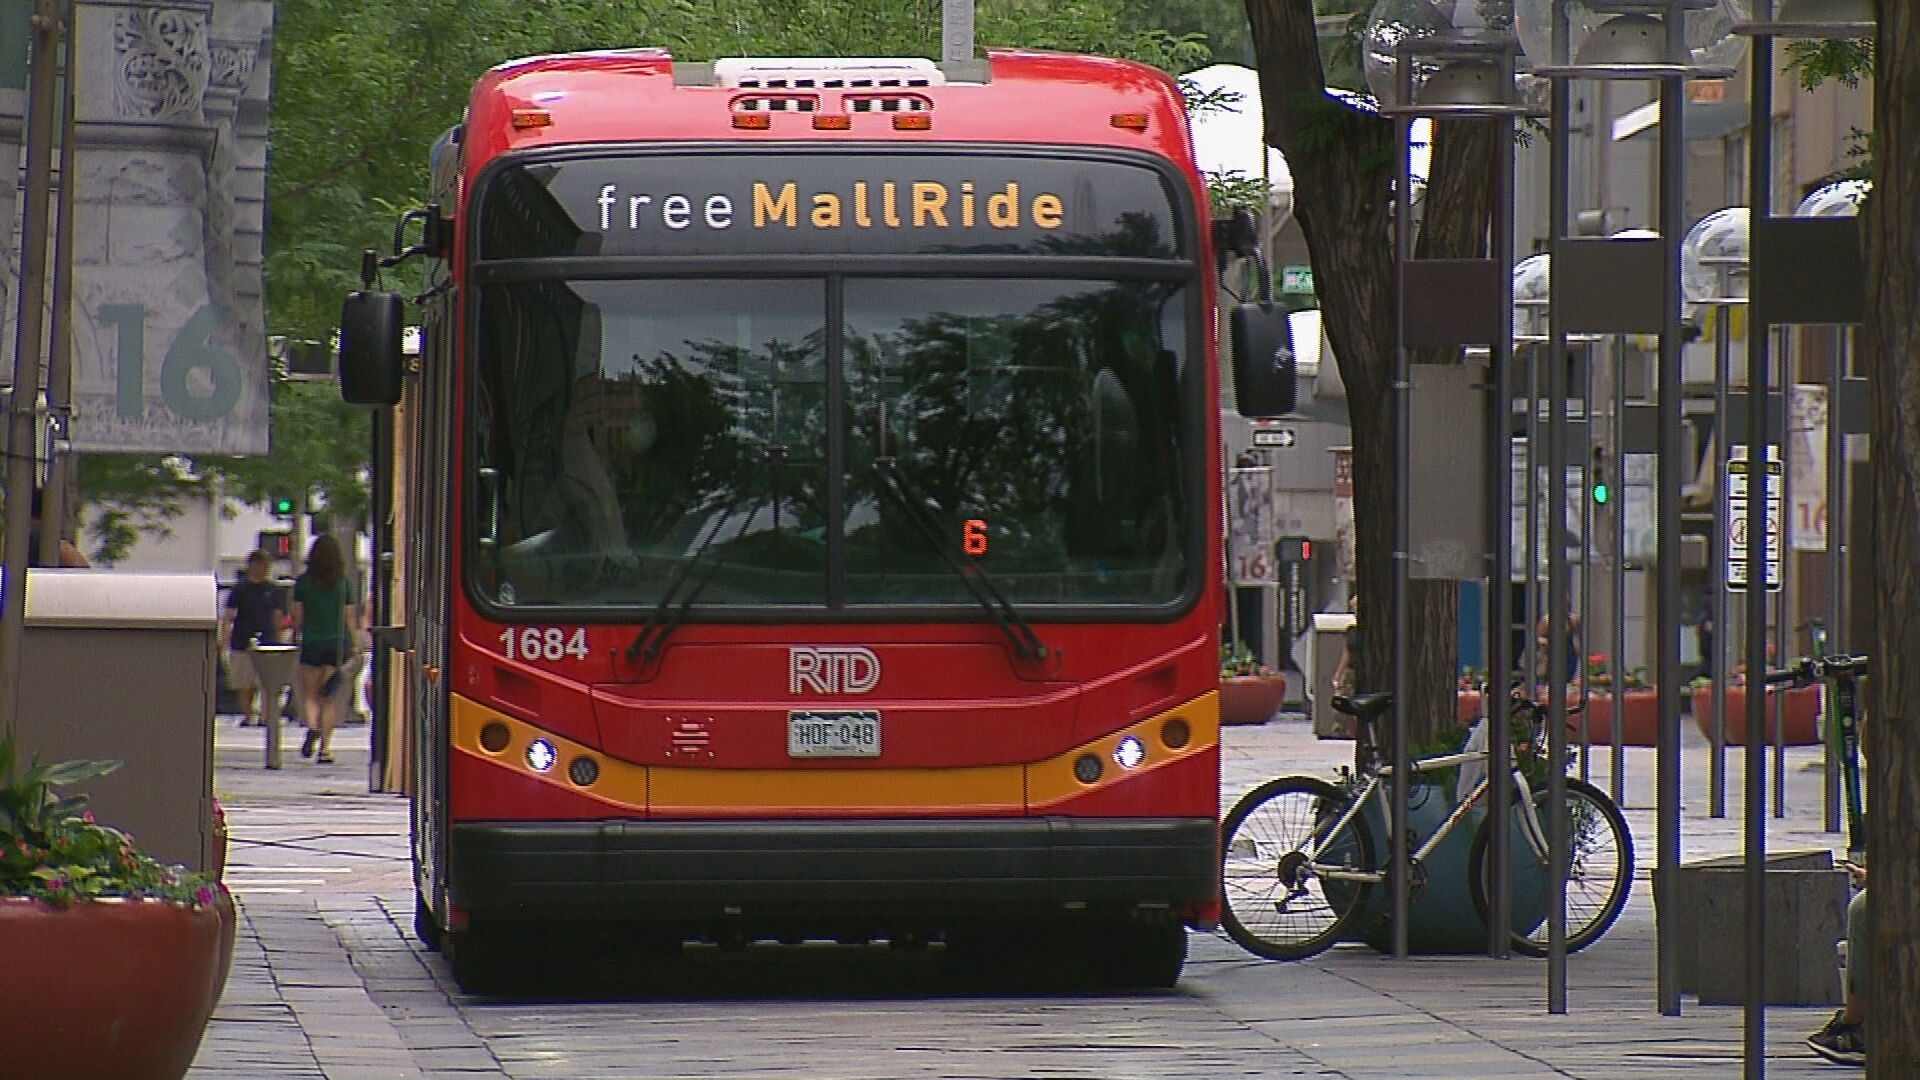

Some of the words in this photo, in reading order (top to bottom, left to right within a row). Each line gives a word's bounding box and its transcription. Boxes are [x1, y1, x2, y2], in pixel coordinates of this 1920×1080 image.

[598, 183, 735, 229] free
[752, 182, 1064, 228] MallRide
[98, 303, 242, 420] 16
[963, 518, 988, 556] 6
[1238, 553, 1266, 579] 16
[499, 627, 589, 660] 1684
[789, 647, 880, 692] RTD
